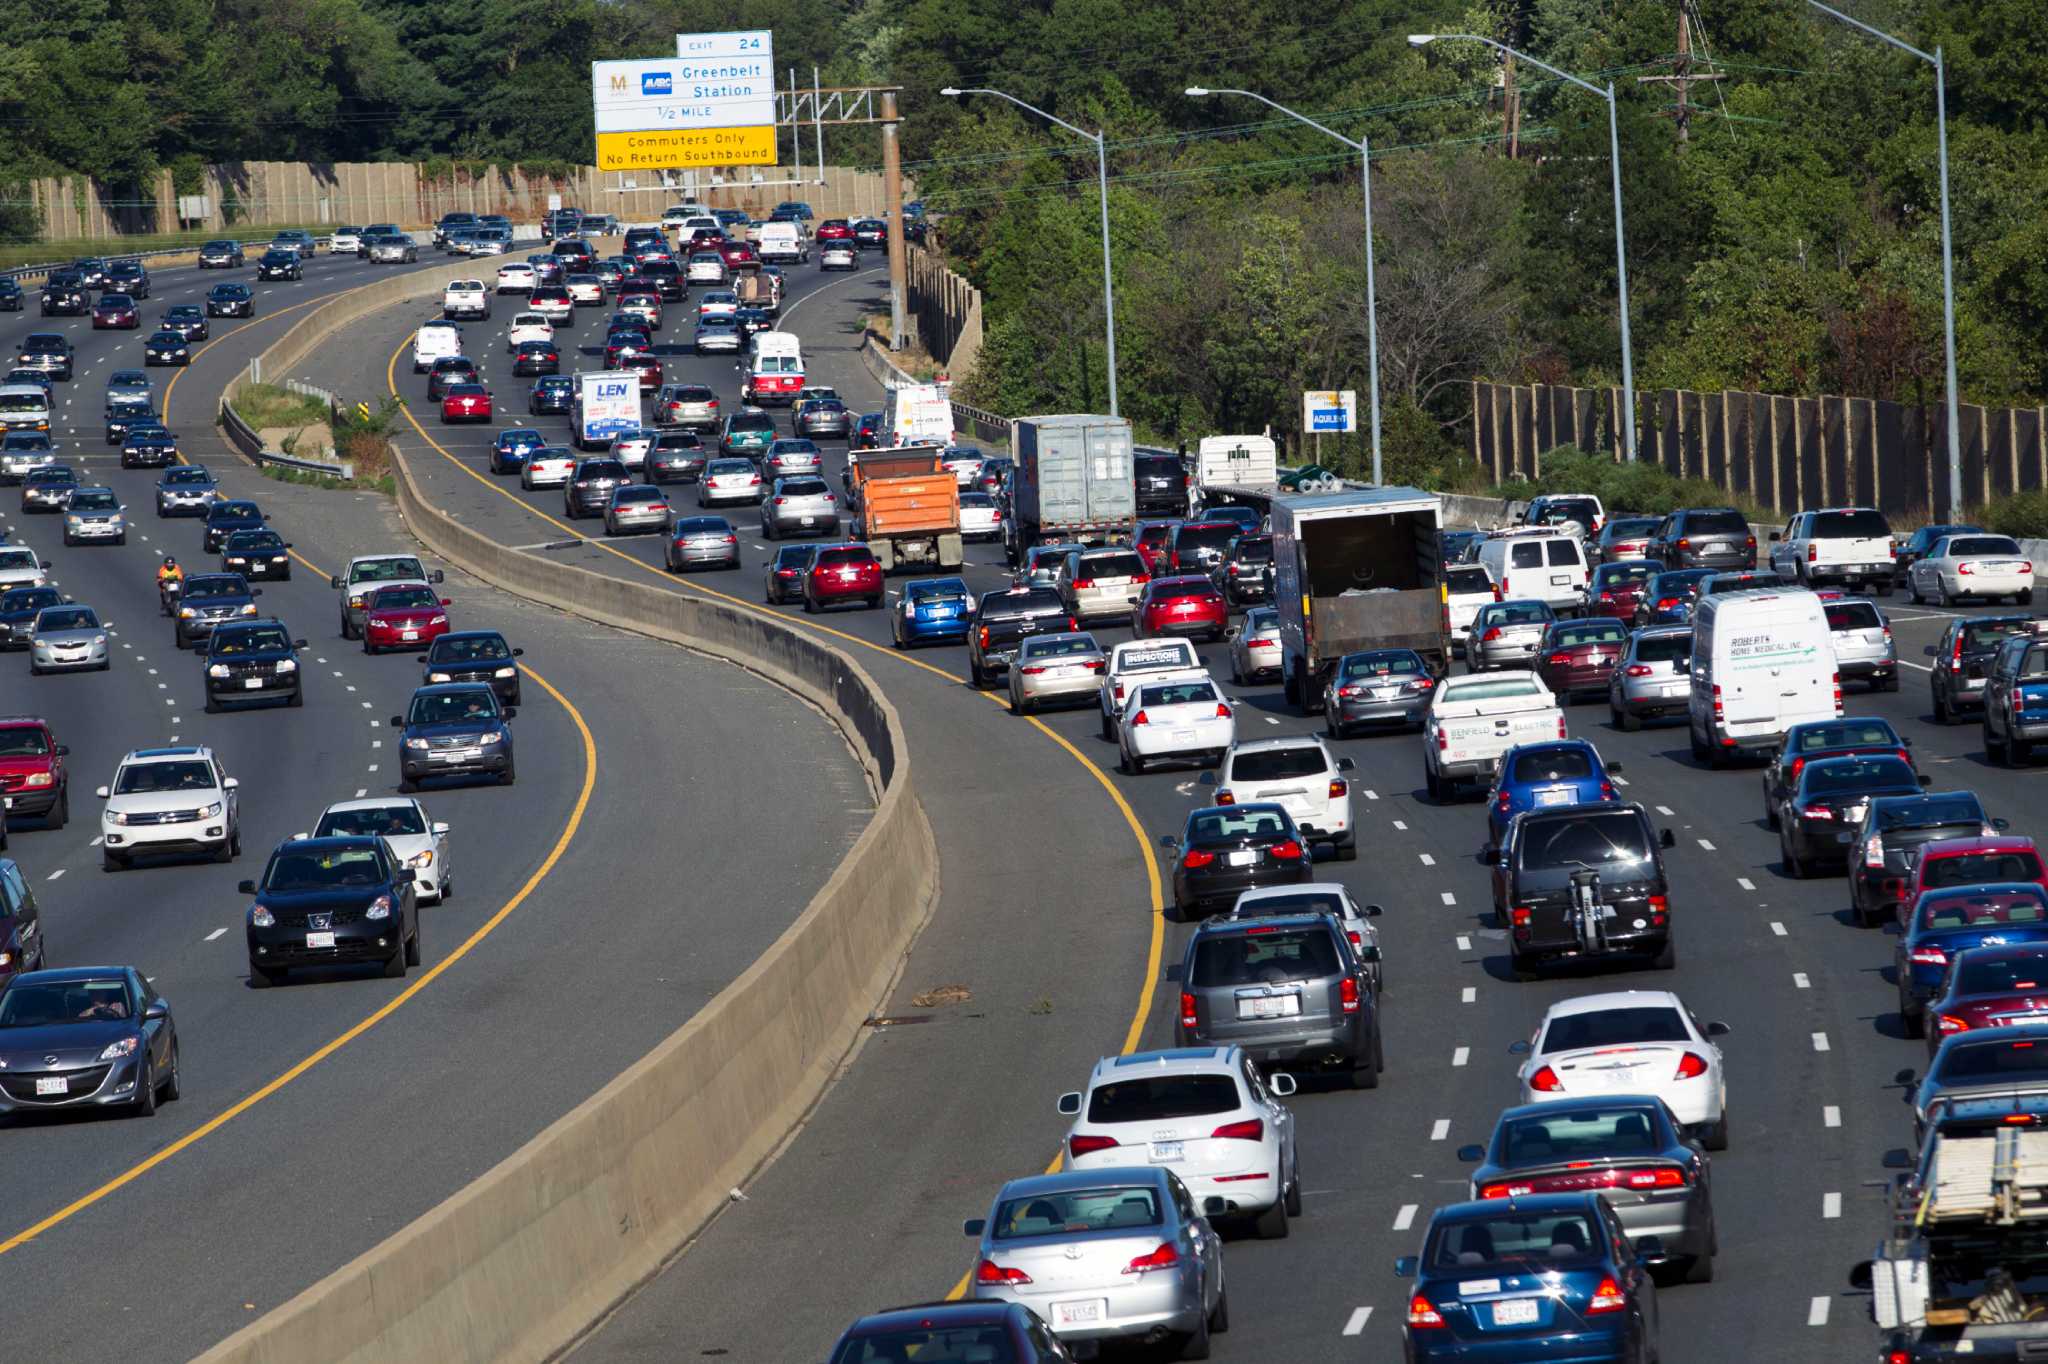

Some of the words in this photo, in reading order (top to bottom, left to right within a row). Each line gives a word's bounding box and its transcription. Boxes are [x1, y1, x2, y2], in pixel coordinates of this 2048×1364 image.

[689, 41, 713, 50] EXIT
[739, 38, 760, 50] 24
[682, 65, 761, 79] Greenbelt
[611, 75, 627, 90] M
[693, 85, 752, 98] Station
[682, 106, 712, 117] MILE
[627, 134, 708, 148] Commuters
[715, 133, 746, 145] Only
[607, 154, 623, 165] No
[631, 152, 678, 163] Return
[684, 148, 768, 161] Southbound
[597, 384, 627, 396] LEN
[1127, 650, 1180, 662] INSPECTIONS
[1731, 647, 1753, 656] HOME
[1450, 726, 1489, 737] BENFIELD
[1514, 720, 1552, 730] ELECTRIC
